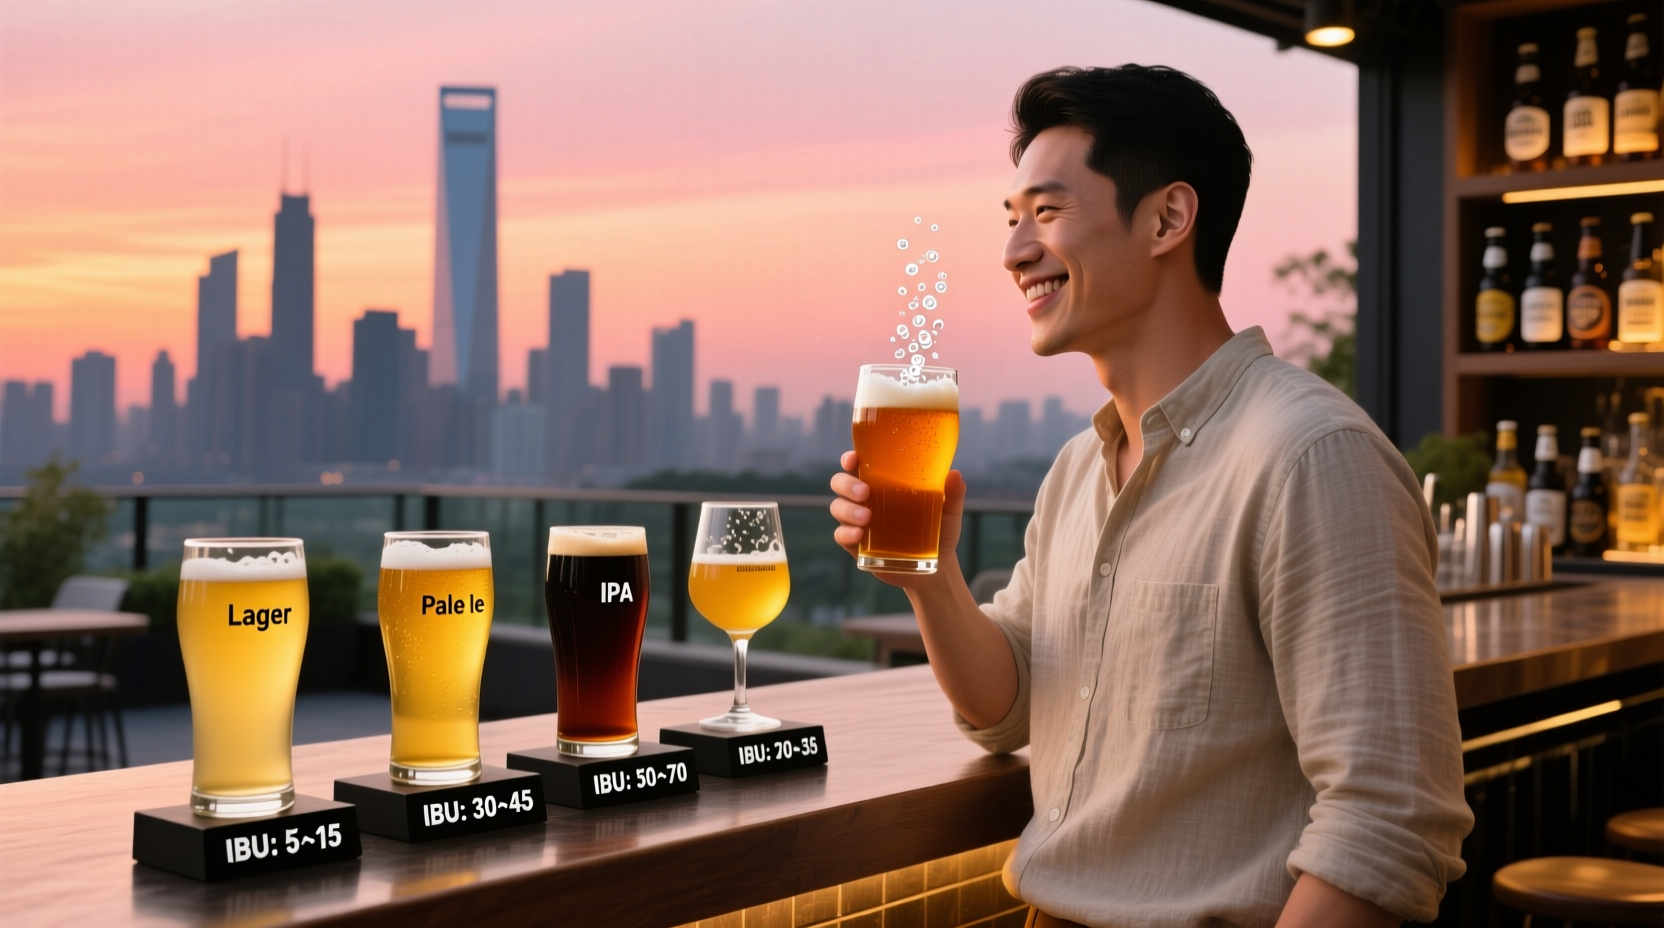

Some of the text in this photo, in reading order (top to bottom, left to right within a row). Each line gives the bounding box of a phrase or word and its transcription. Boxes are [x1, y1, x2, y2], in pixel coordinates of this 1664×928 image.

[421, 594, 465, 616] Pale
[601, 582, 633, 603] IPA
[228, 603, 292, 632] Lager
[738, 743, 771, 765] IBU:
[593, 770, 632, 795] IBU:
[423, 789, 534, 827] IBU: 30~45
[225, 823, 342, 863] IBU: 5~15
